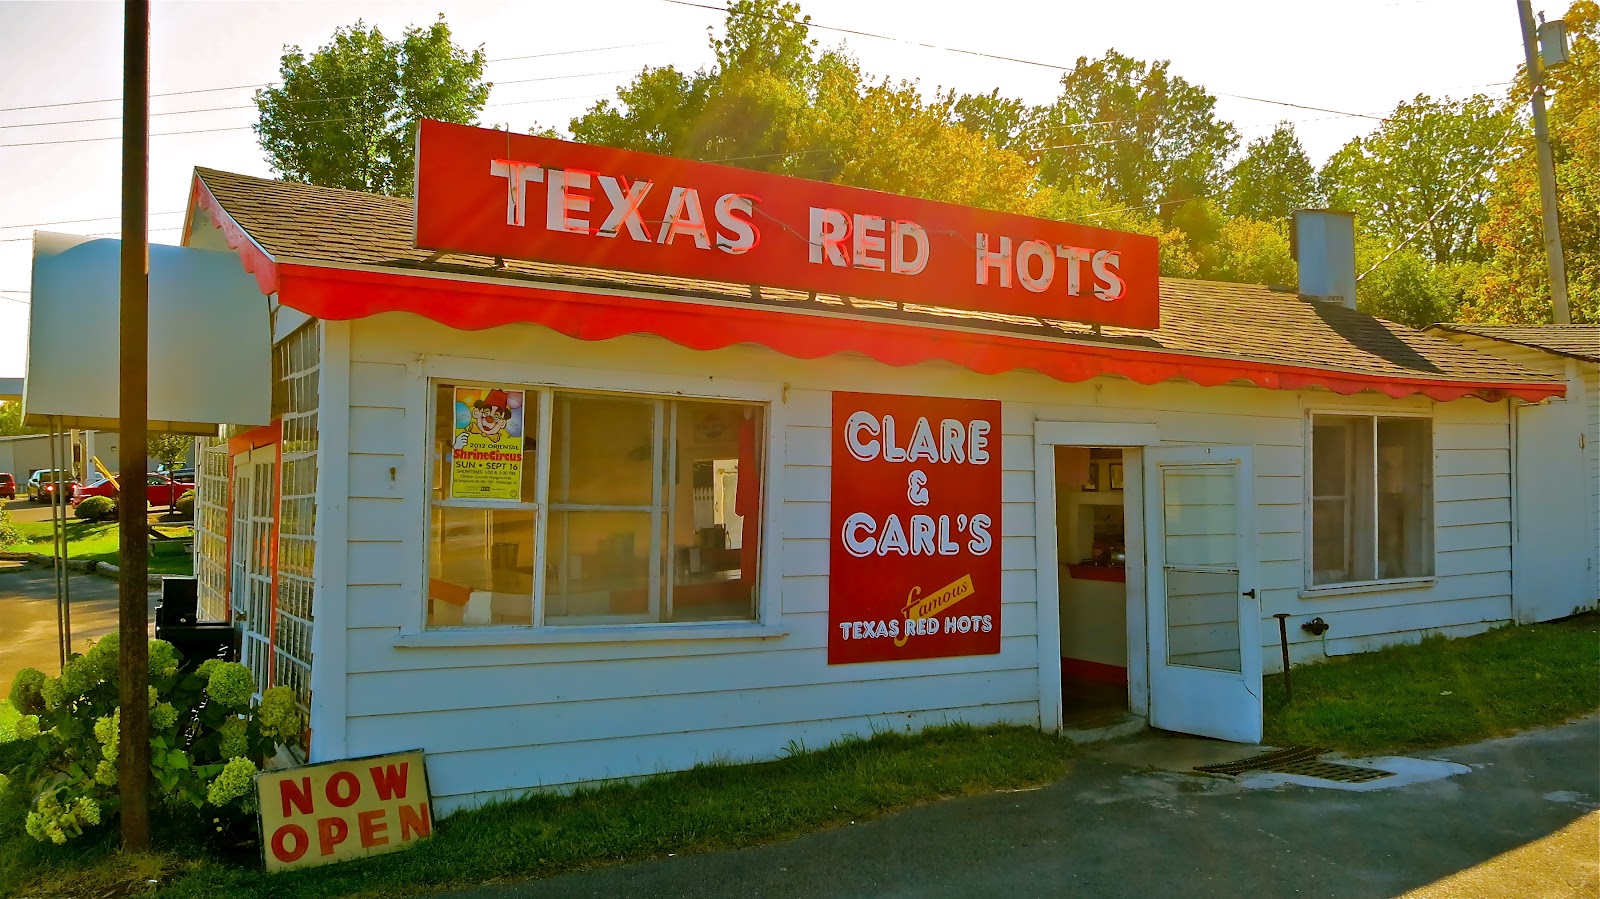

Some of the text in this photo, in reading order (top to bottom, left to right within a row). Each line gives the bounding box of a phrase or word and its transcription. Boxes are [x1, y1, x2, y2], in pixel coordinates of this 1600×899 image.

[490, 159, 1126, 302] TEXAS RED HOTS
[453, 449, 522, 461] ShrineCircus
[844, 410, 992, 465] CLARE
[485, 462, 506, 470] SEPT
[509, 463, 518, 471] 16
[908, 470, 929, 506] &
[841, 511, 993, 558] CARL'S
[839, 614, 993, 641] TEXAS RED HOTS
[893, 580, 970, 647] famous
[279, 762, 409, 818] NOW
[270, 802, 431, 863] OPEN
